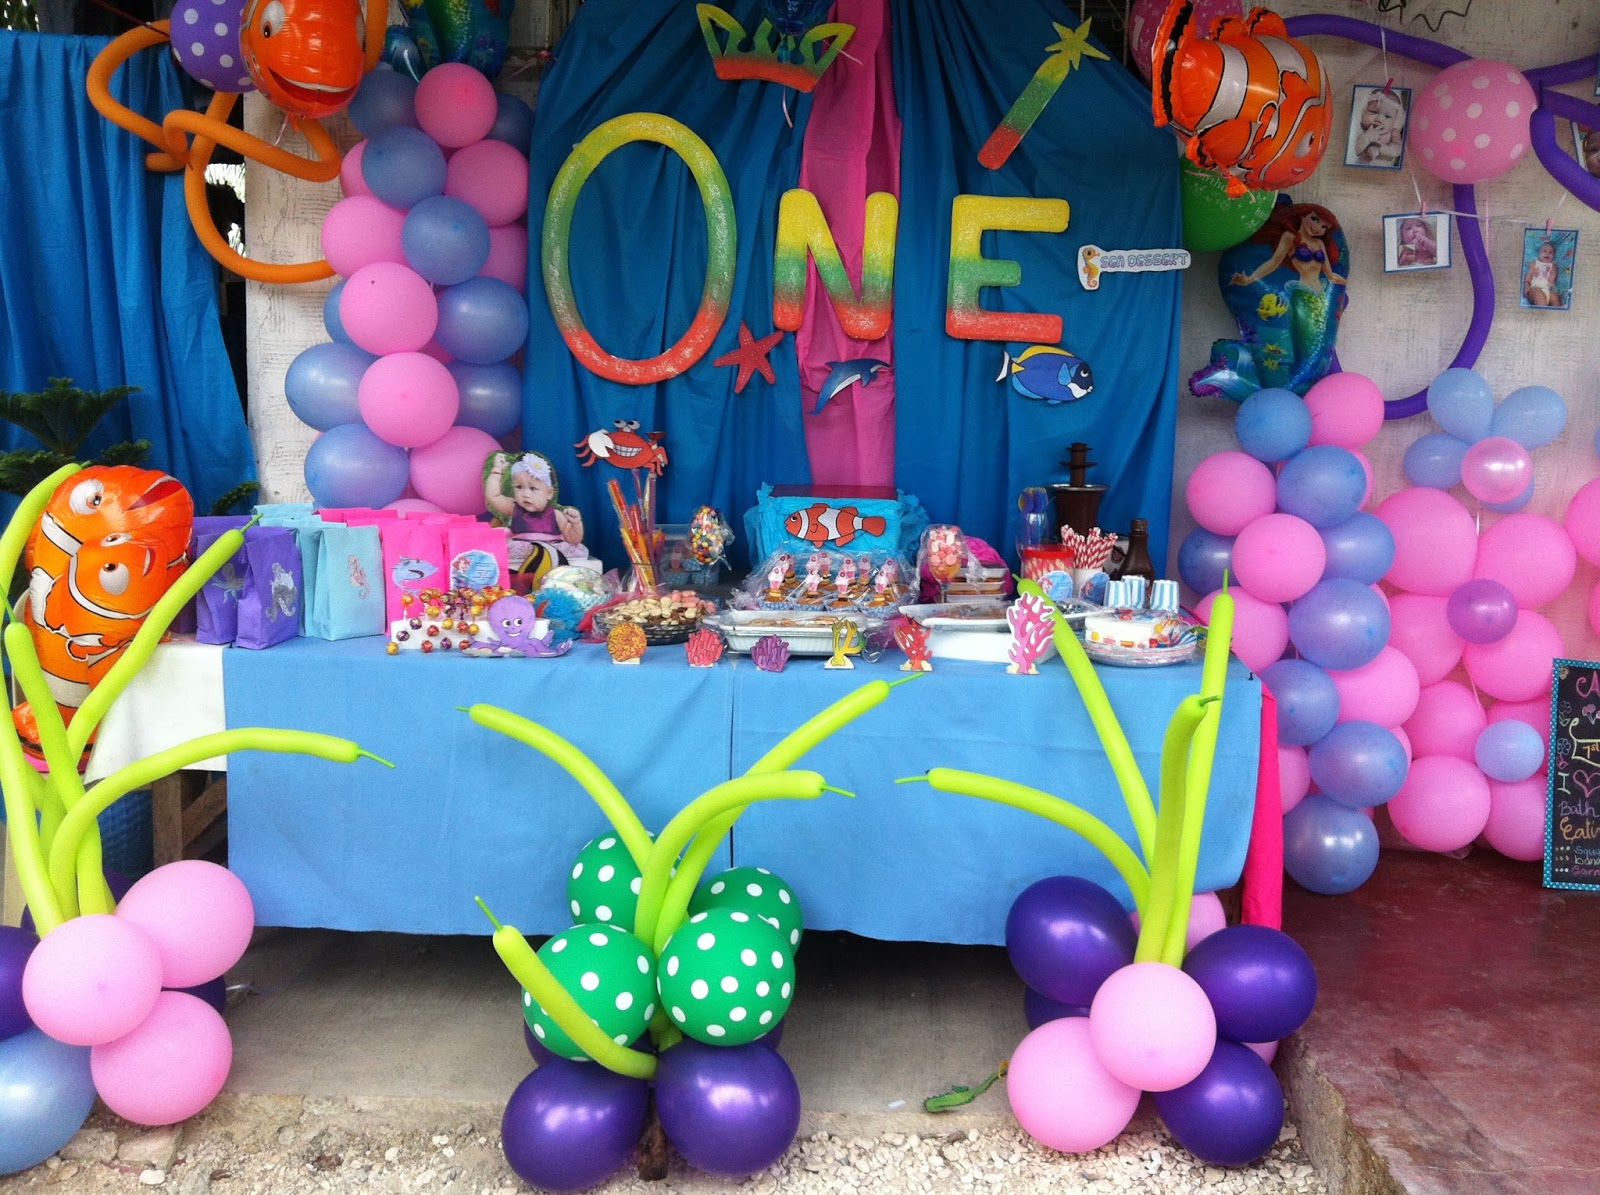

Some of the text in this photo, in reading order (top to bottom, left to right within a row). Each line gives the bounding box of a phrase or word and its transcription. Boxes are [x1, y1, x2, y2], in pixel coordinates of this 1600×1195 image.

[541, 111, 1070, 385] ONE
[1100, 252, 1189, 269] SEA DESSERT
[1557, 771, 1571, 795] I
[1558, 799, 1600, 817] Bath
